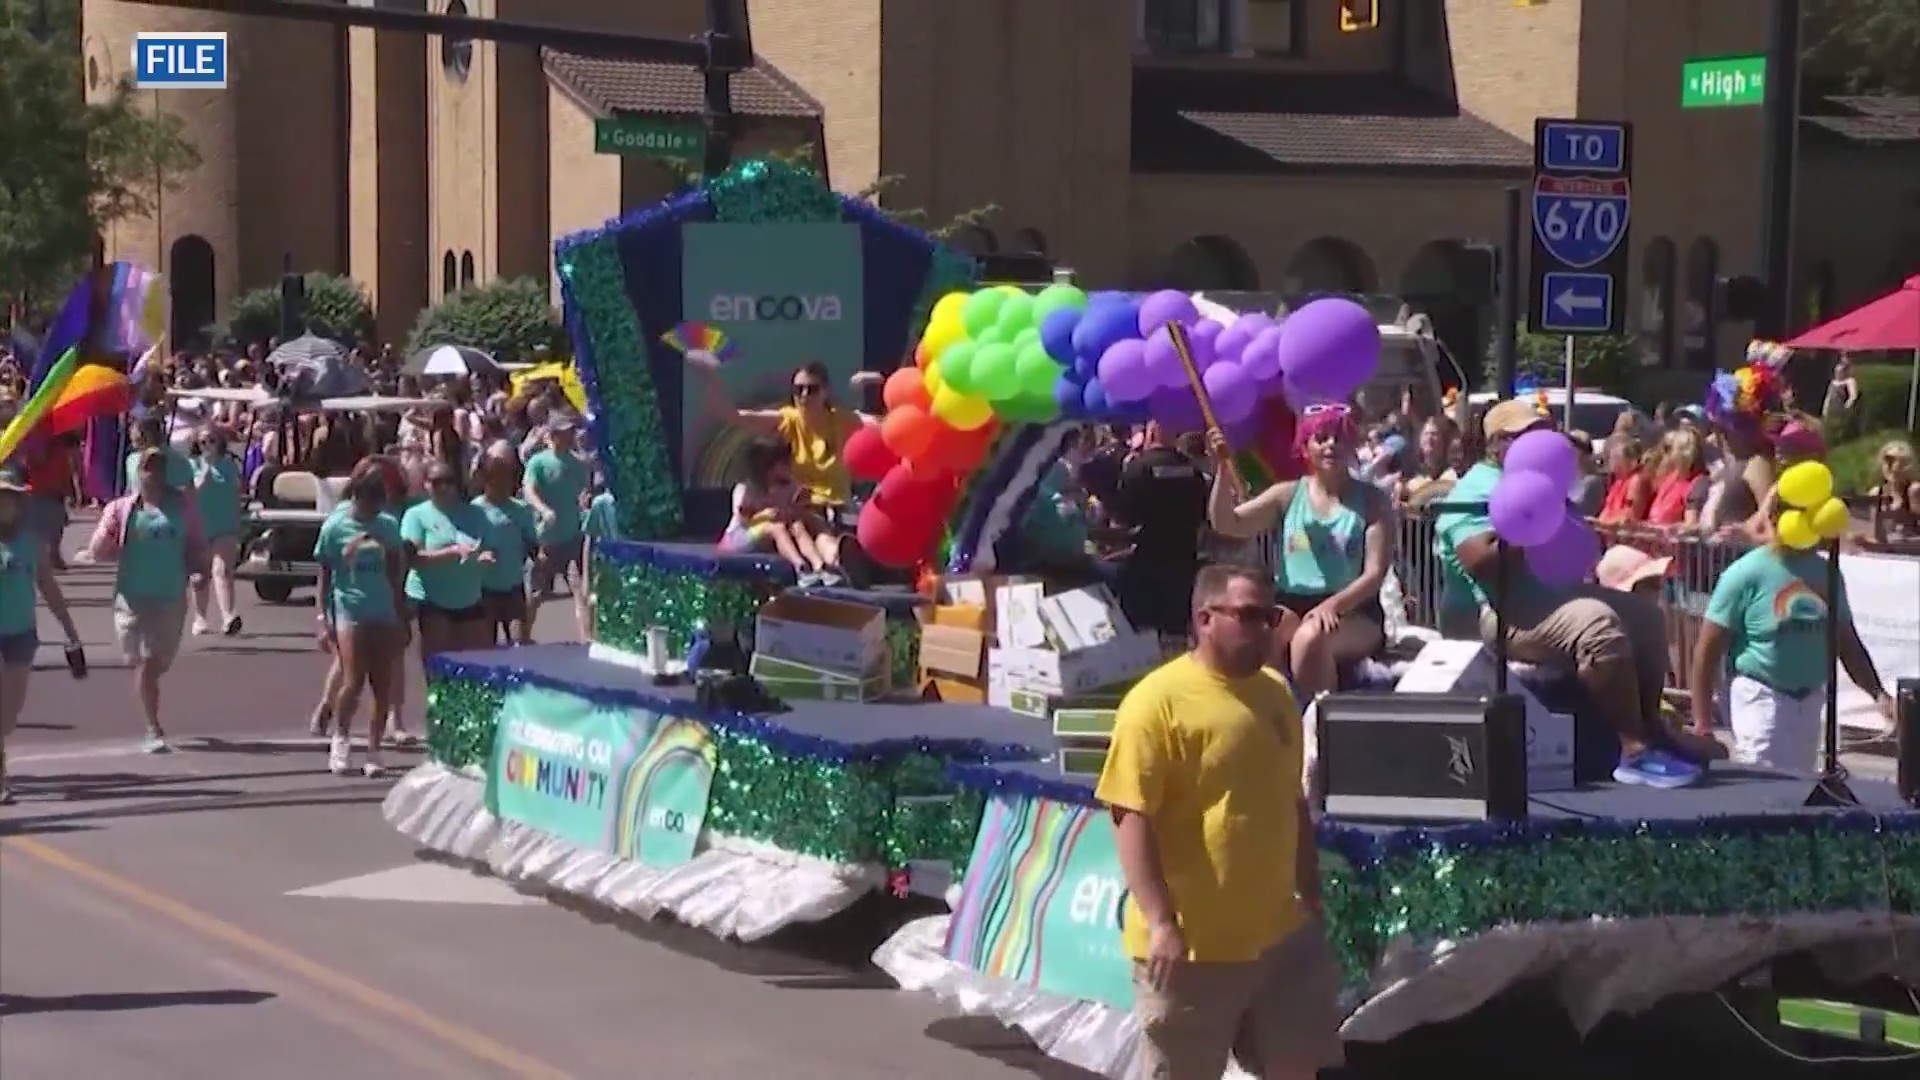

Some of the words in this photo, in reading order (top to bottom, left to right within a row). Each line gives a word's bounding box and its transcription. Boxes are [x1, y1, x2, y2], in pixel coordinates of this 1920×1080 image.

[1701, 69, 1746, 102] High
[613, 128, 682, 149] Goodale
[1565, 134, 1604, 161] TO
[1544, 200, 1618, 242] 670
[710, 294, 842, 321] encova
